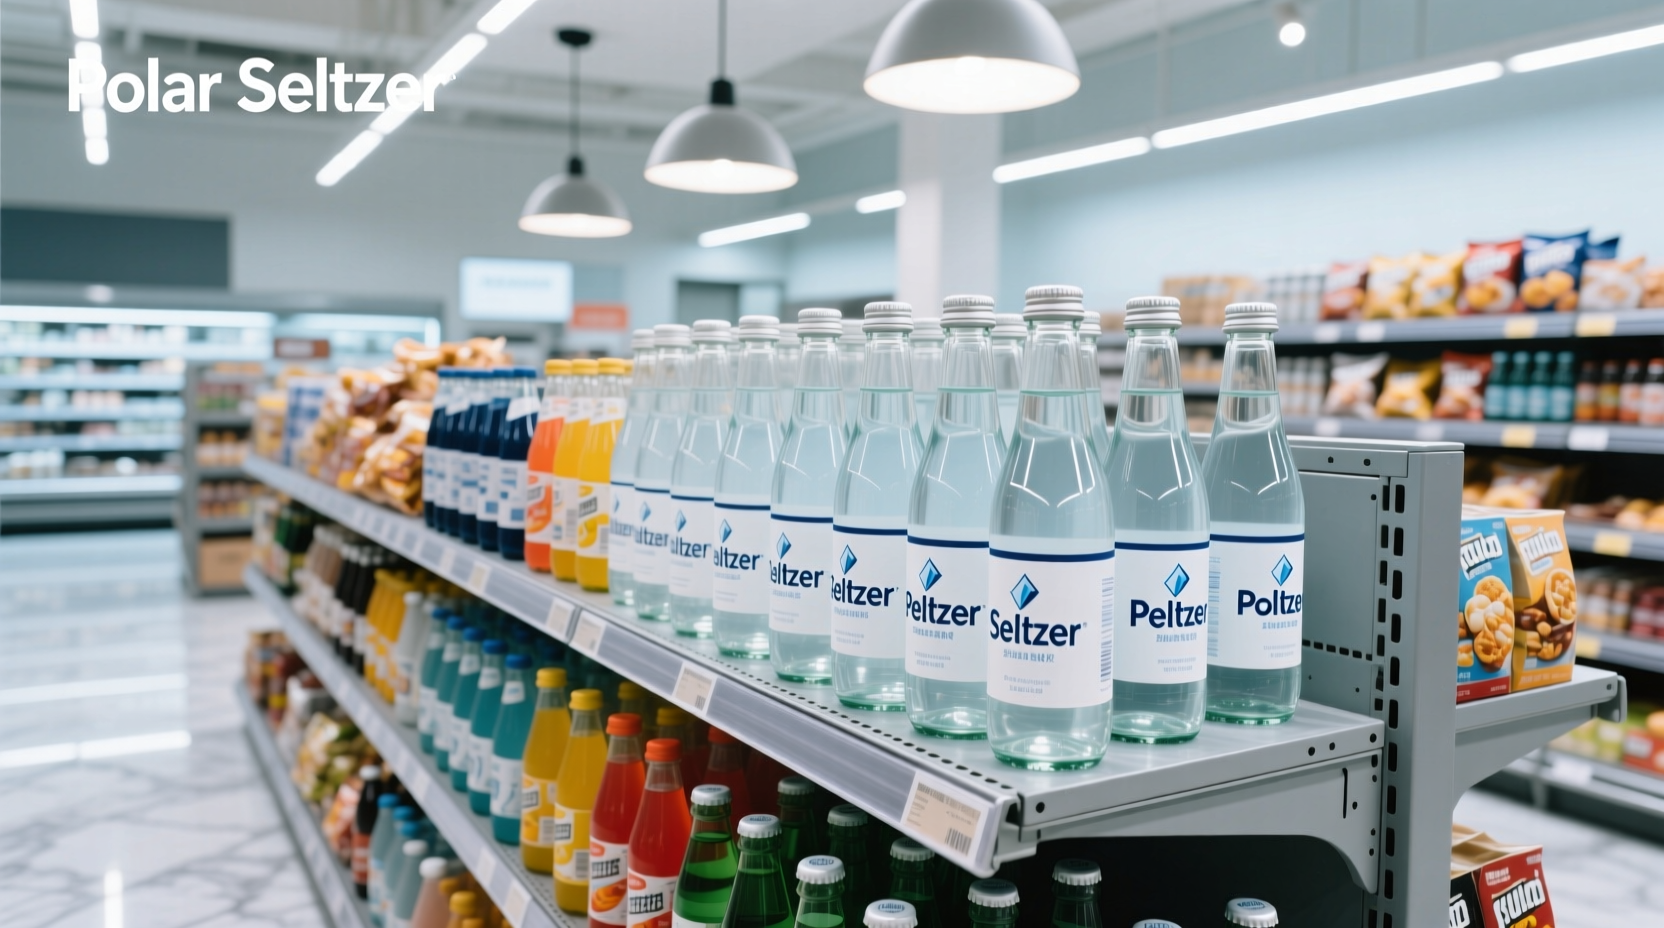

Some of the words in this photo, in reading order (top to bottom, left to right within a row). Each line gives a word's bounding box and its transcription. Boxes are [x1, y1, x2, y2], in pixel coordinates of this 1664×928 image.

[769, 559, 824, 589] eltzer
[905, 590, 982, 627] Peltzer
[1130, 598, 1208, 629] Peltzer
[1237, 589, 1303, 616] Poltze
[990, 608, 1082, 647] Seltzer
